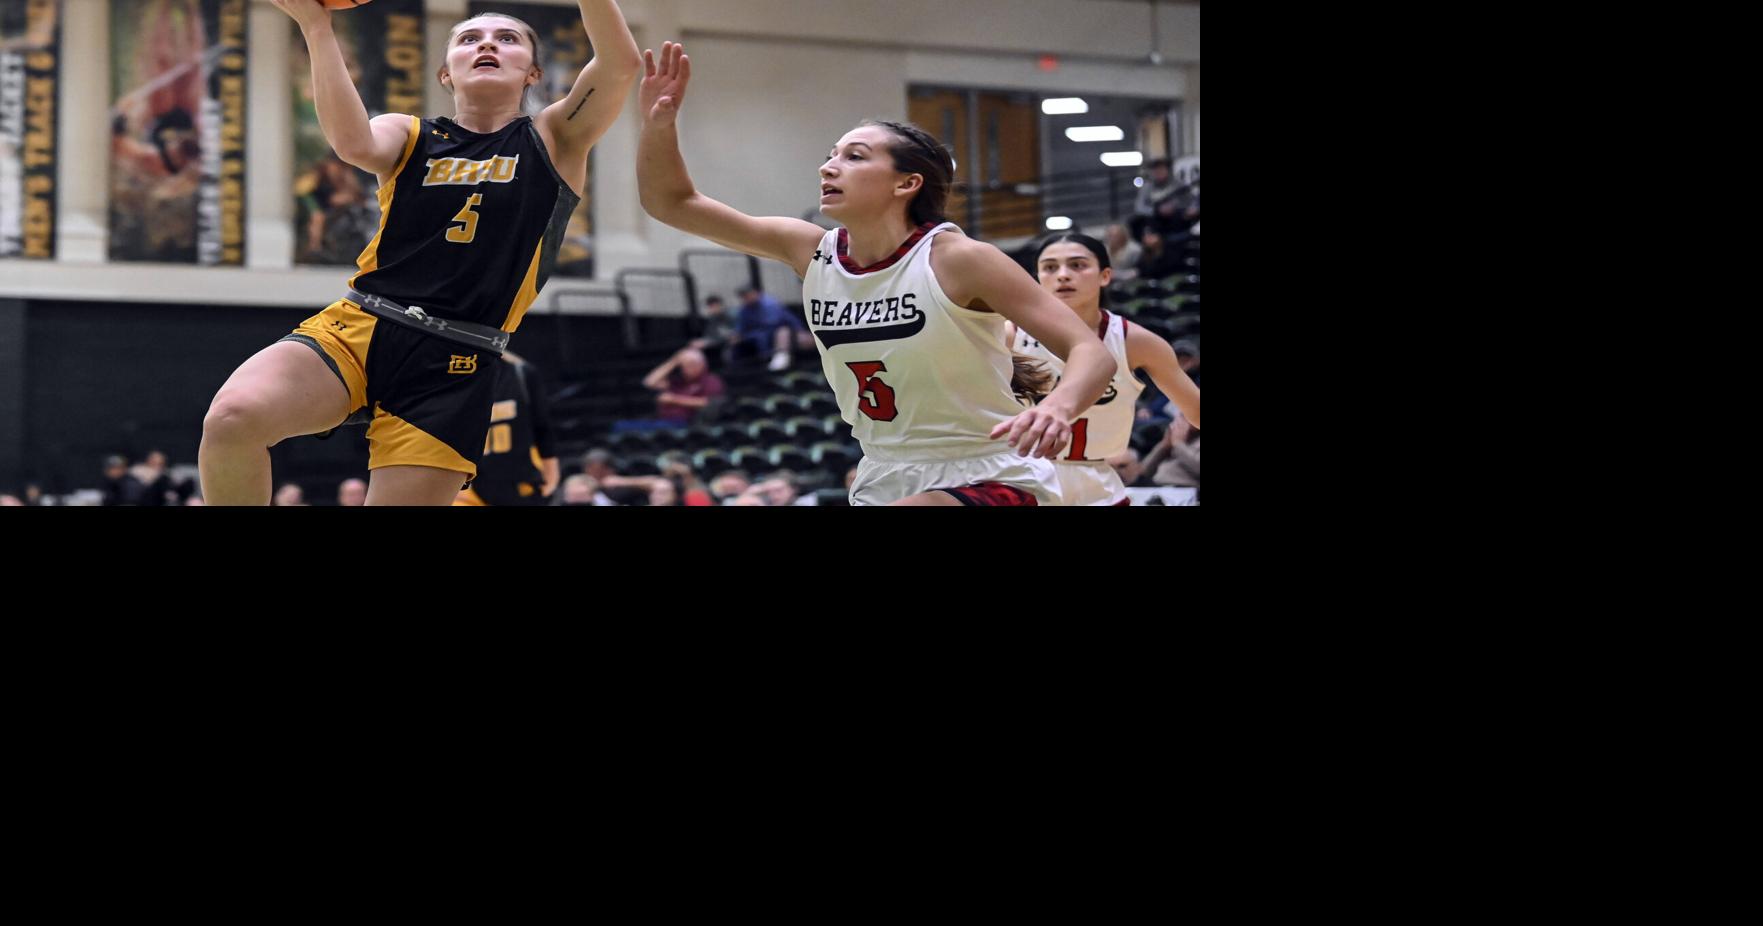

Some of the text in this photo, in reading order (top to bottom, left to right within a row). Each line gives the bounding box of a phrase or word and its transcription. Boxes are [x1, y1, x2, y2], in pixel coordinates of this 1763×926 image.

[446, 193, 482, 243] 5
[811, 293, 918, 326] BEAVERS
[845, 360, 898, 422] 5
